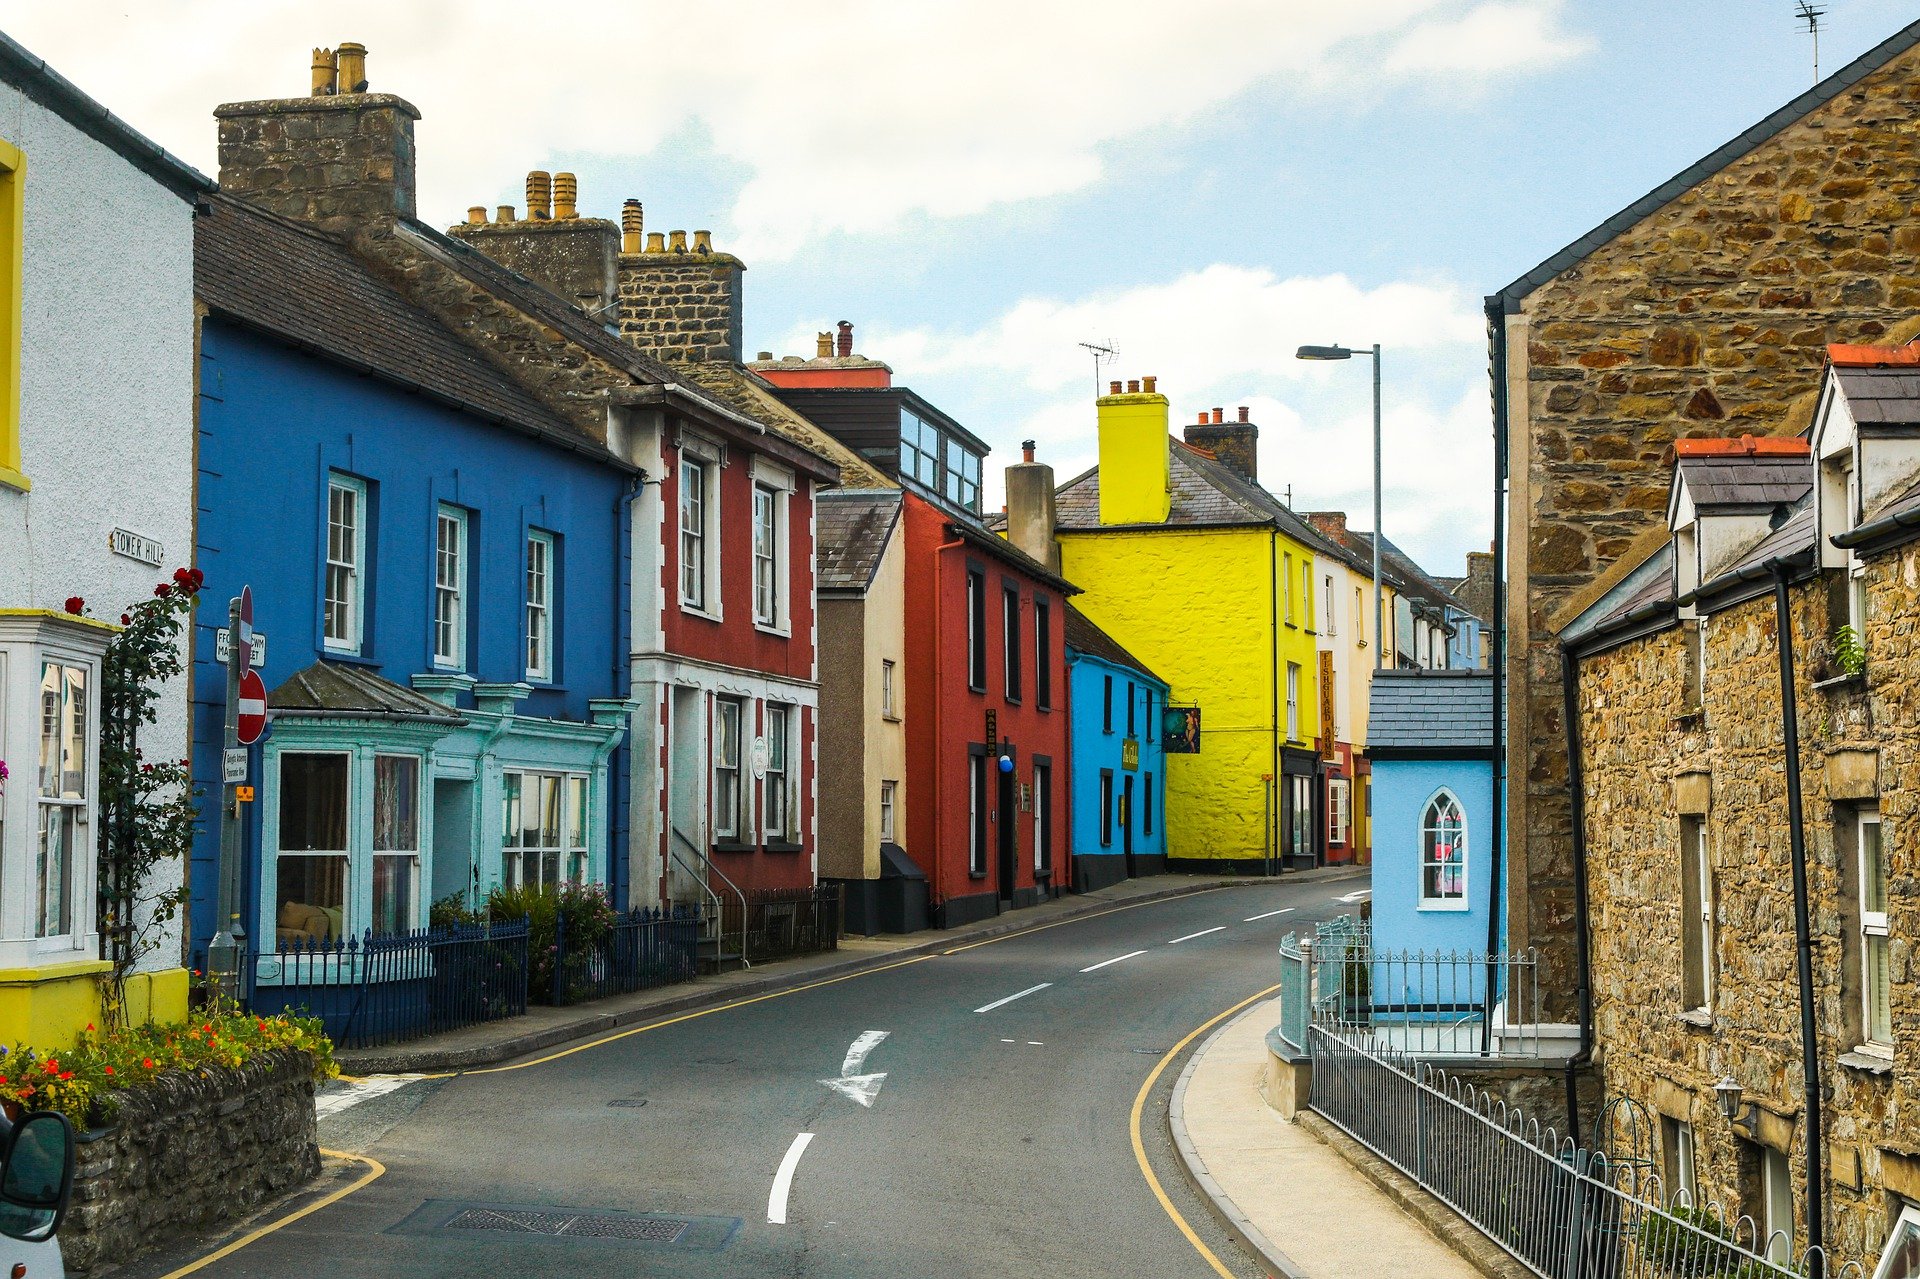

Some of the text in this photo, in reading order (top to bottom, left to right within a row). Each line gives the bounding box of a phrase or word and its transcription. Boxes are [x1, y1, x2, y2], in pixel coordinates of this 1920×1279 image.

[116, 531, 161, 563] TOWER HILL
[1323, 653, 1333, 759] FISHGUARD ARMS
[986, 709, 996, 756] GALLERY
